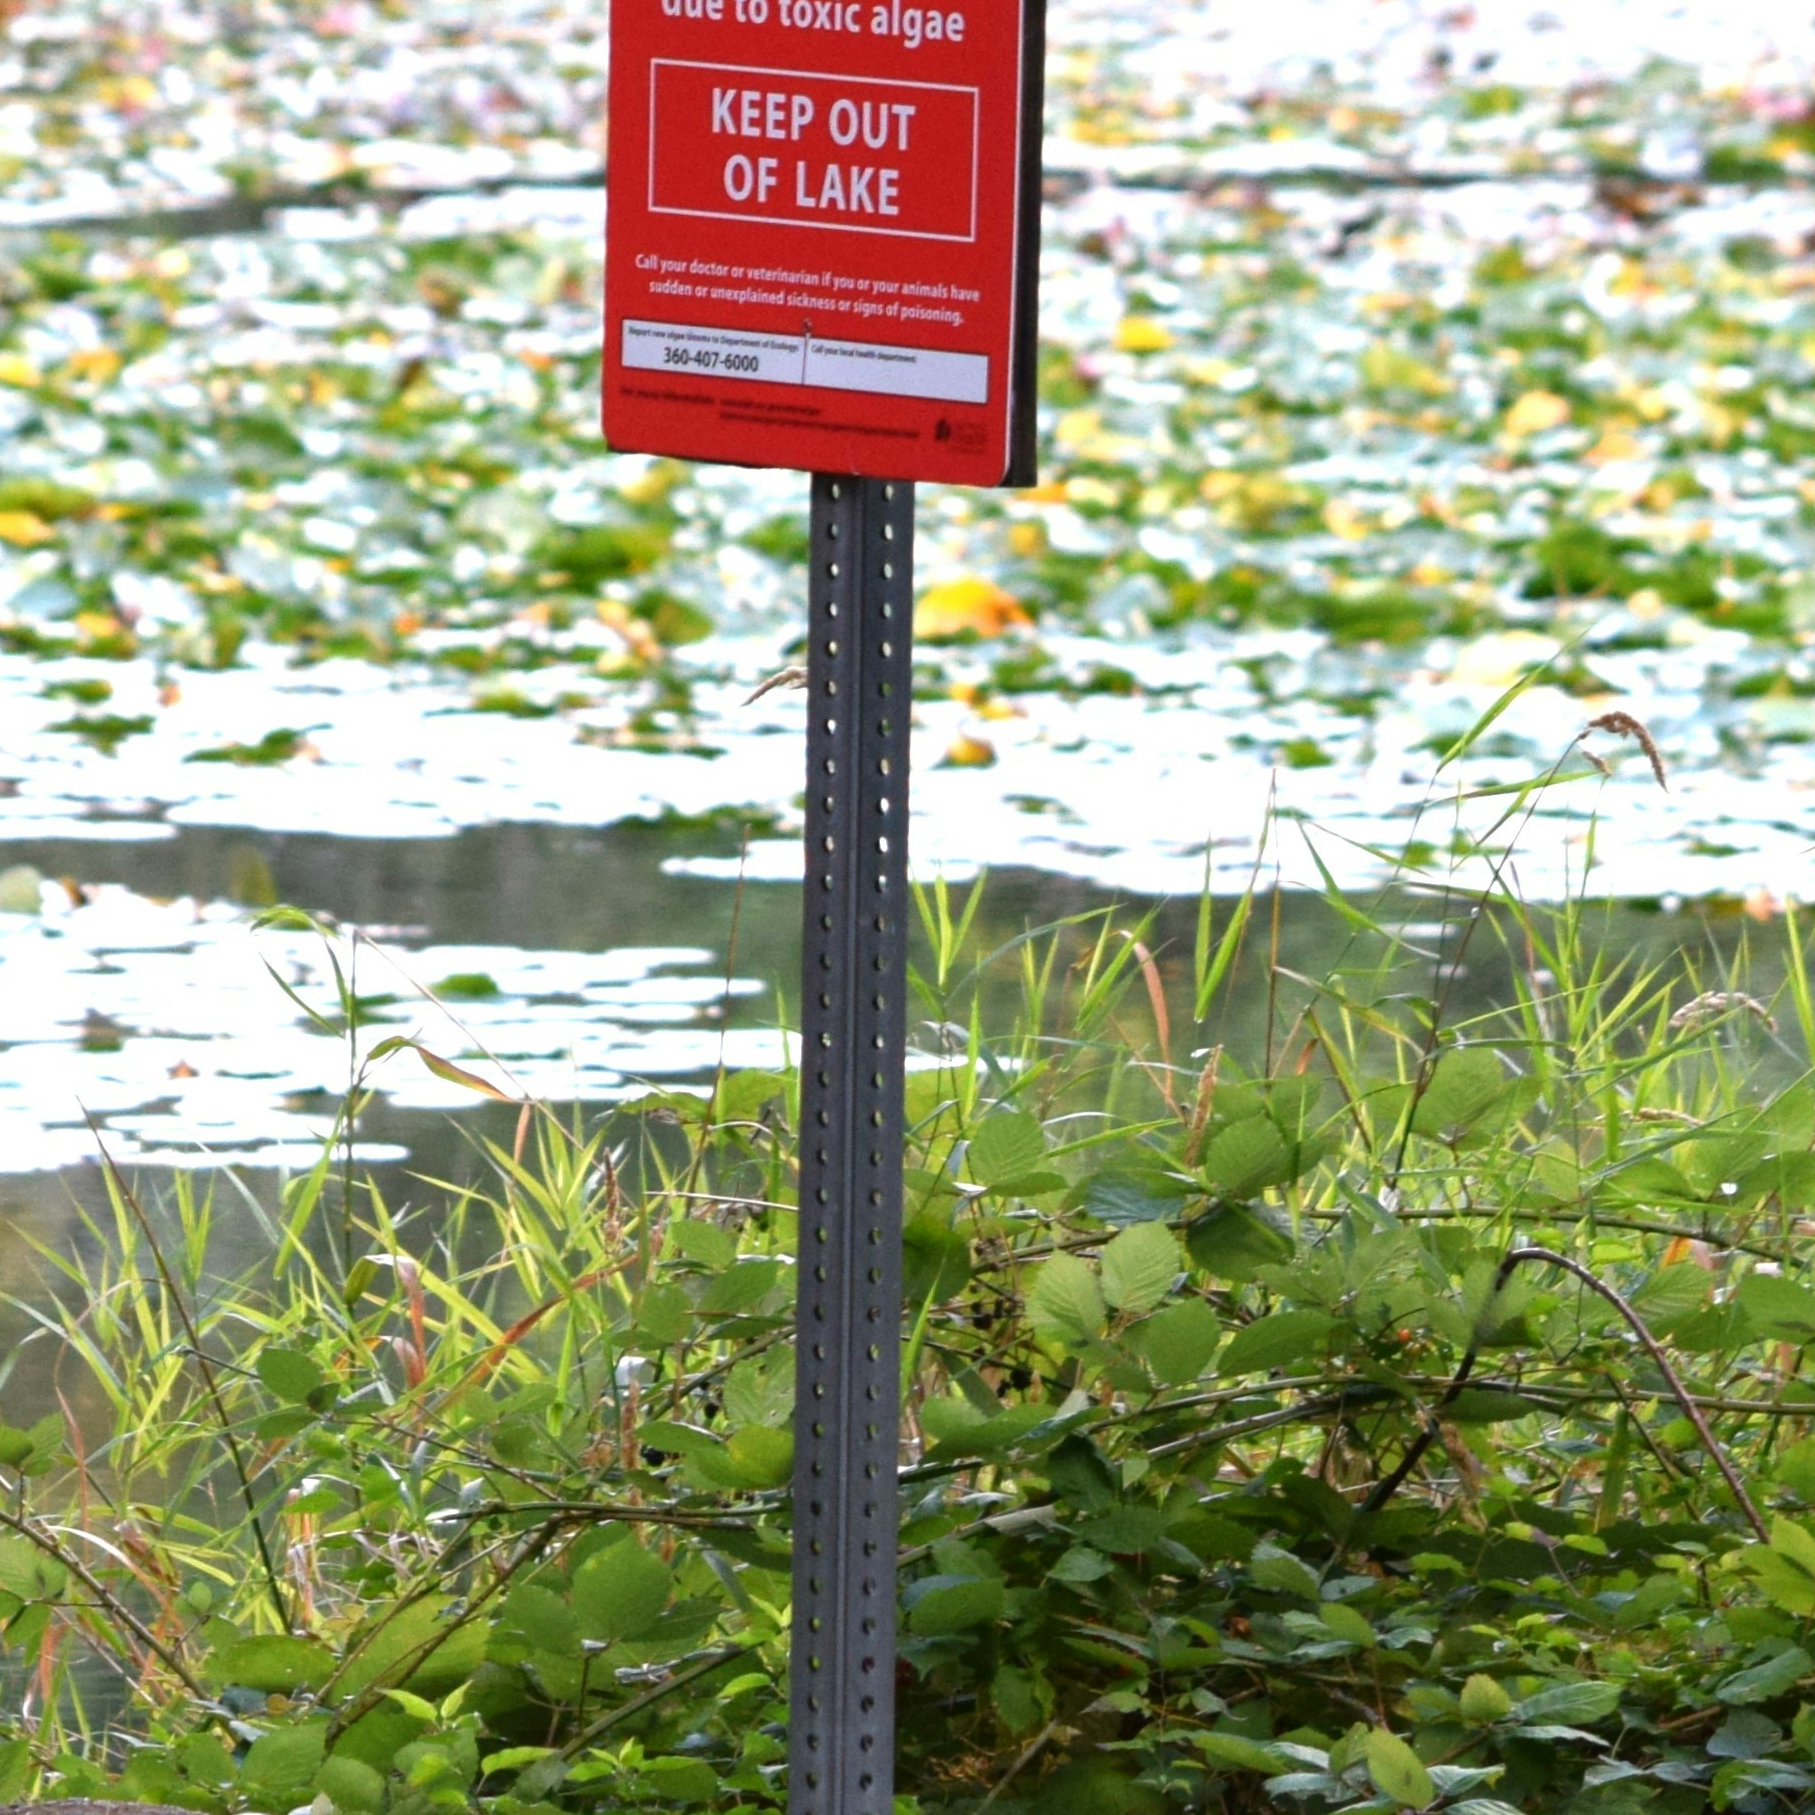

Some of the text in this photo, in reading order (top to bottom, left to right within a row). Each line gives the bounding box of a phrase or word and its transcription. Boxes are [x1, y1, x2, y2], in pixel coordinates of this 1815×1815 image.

[712, 88, 916, 150] KEEP OUT
[724, 154, 900, 216] OF LAKE
[635, 254, 980, 302] Call your doctor or veterinarian if you or your animals have
[649, 279, 964, 327] sudden or unexplained sickness or signs of poisoning.
[663, 347, 759, 372] 360-407-6000
